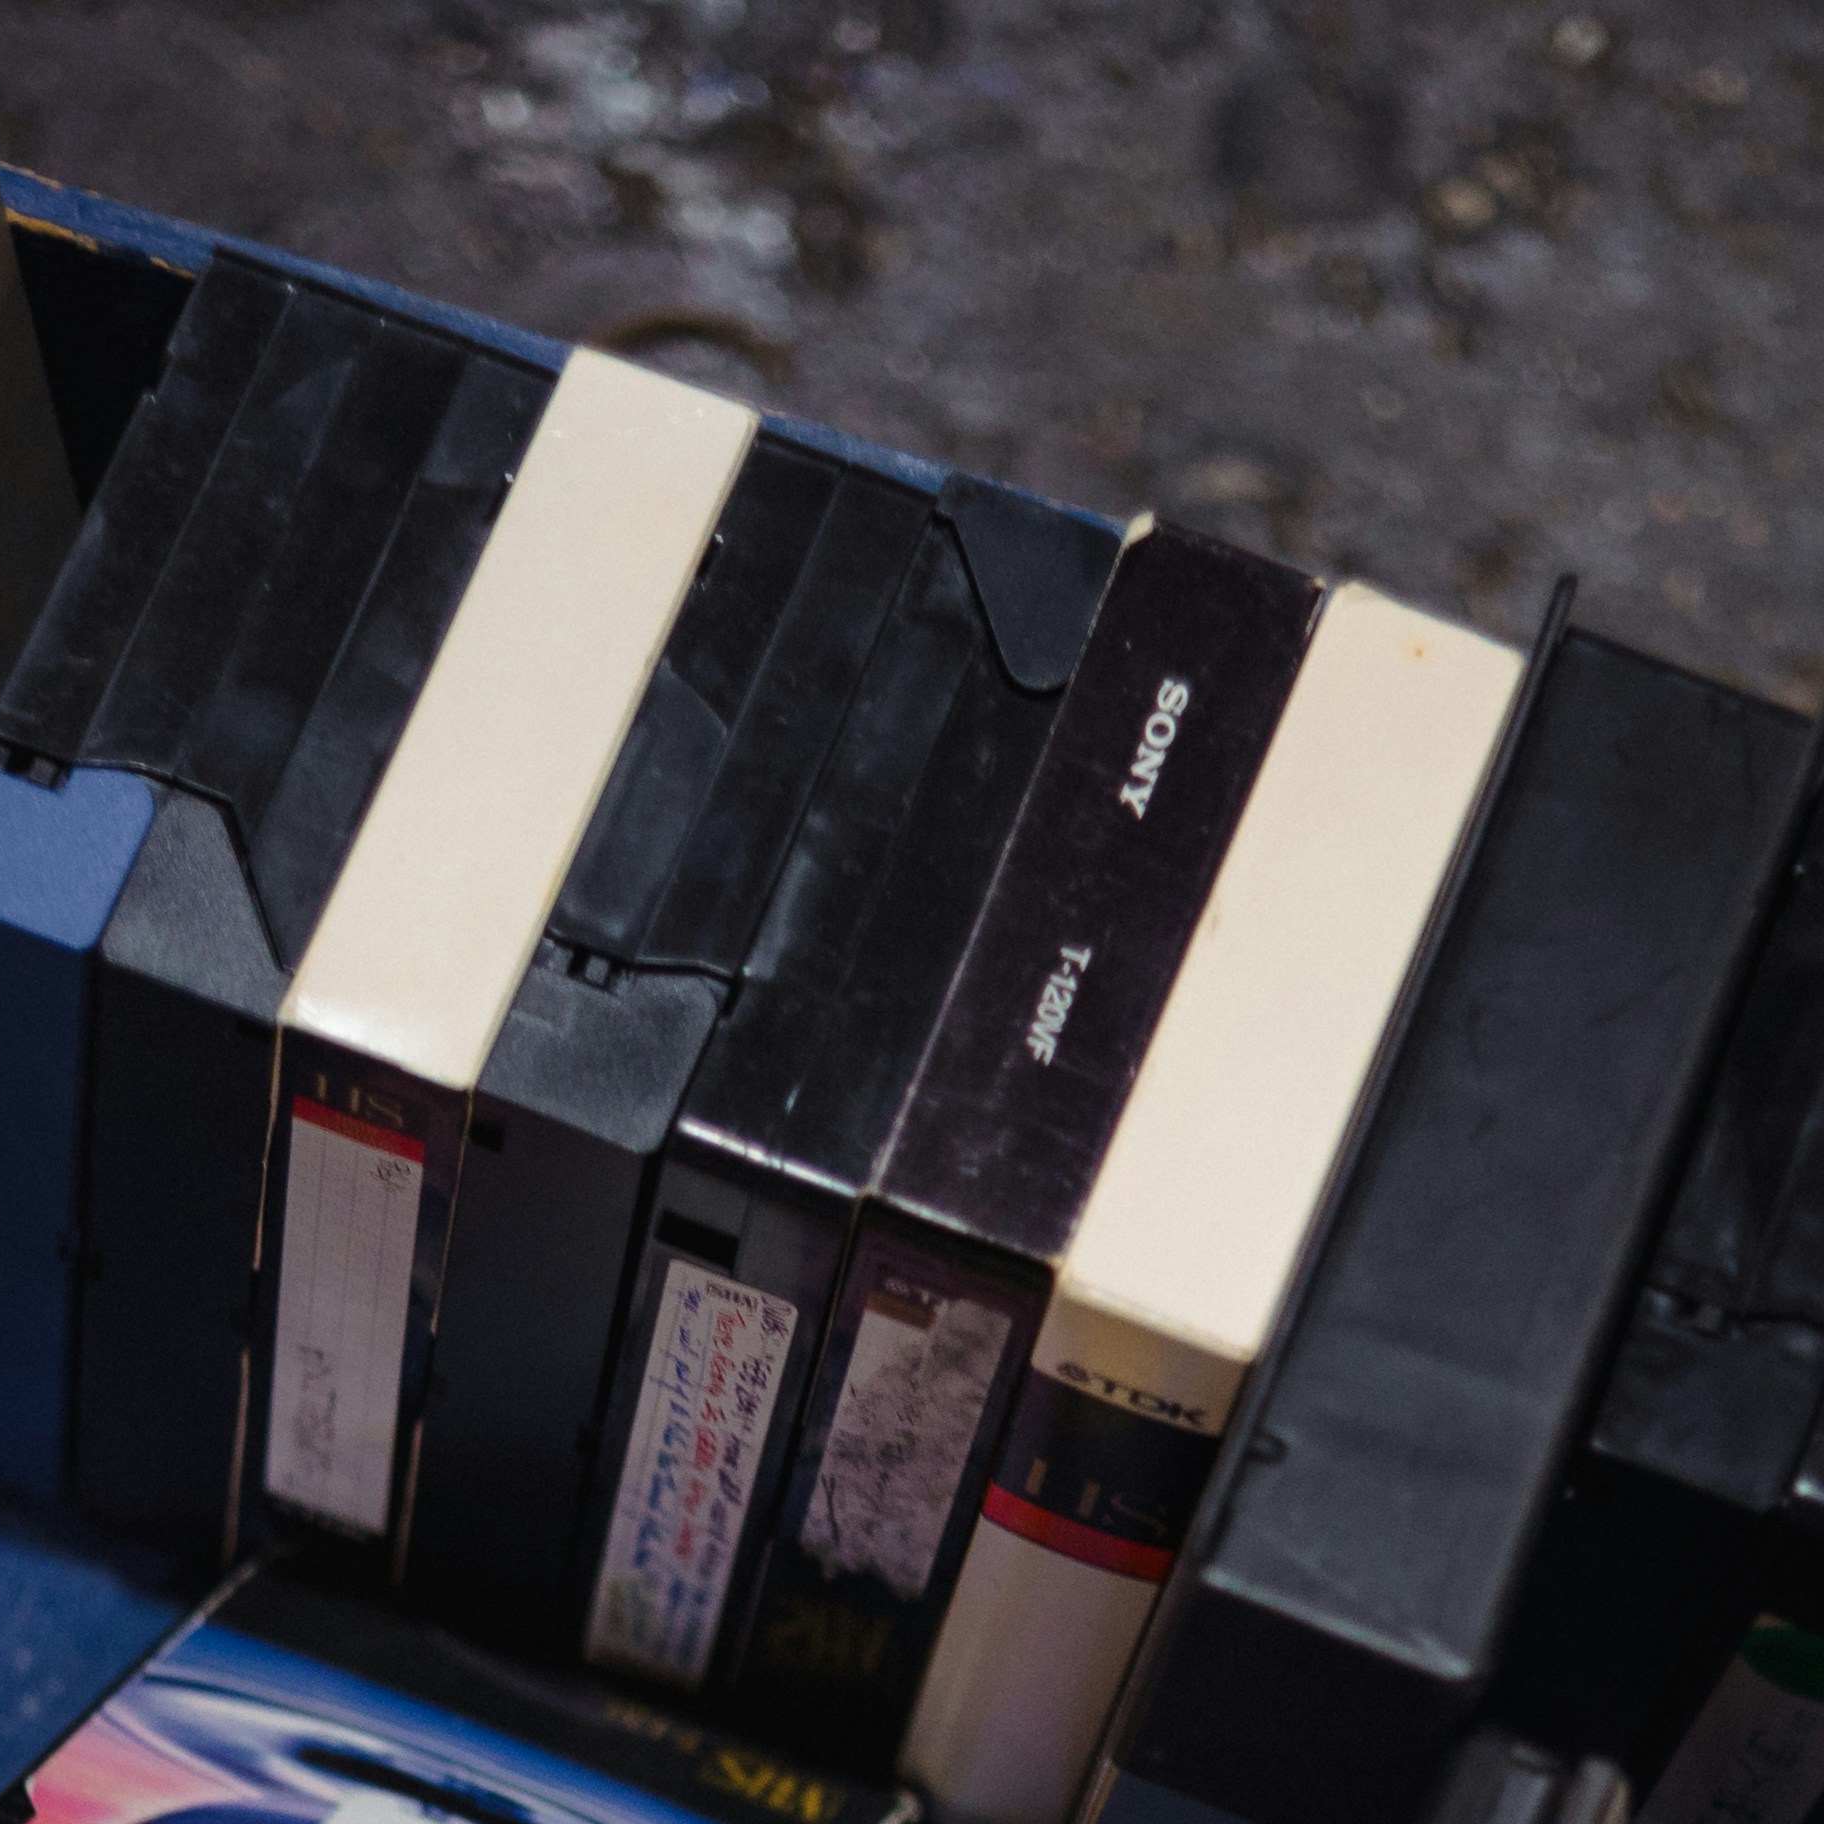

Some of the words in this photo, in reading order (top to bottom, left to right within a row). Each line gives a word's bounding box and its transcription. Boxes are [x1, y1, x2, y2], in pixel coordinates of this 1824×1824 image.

[1113, 675, 1193, 820] SONY
[1020, 942, 1093, 1066] T-120VF
[1088, 1374, 1210, 1430] TDK
